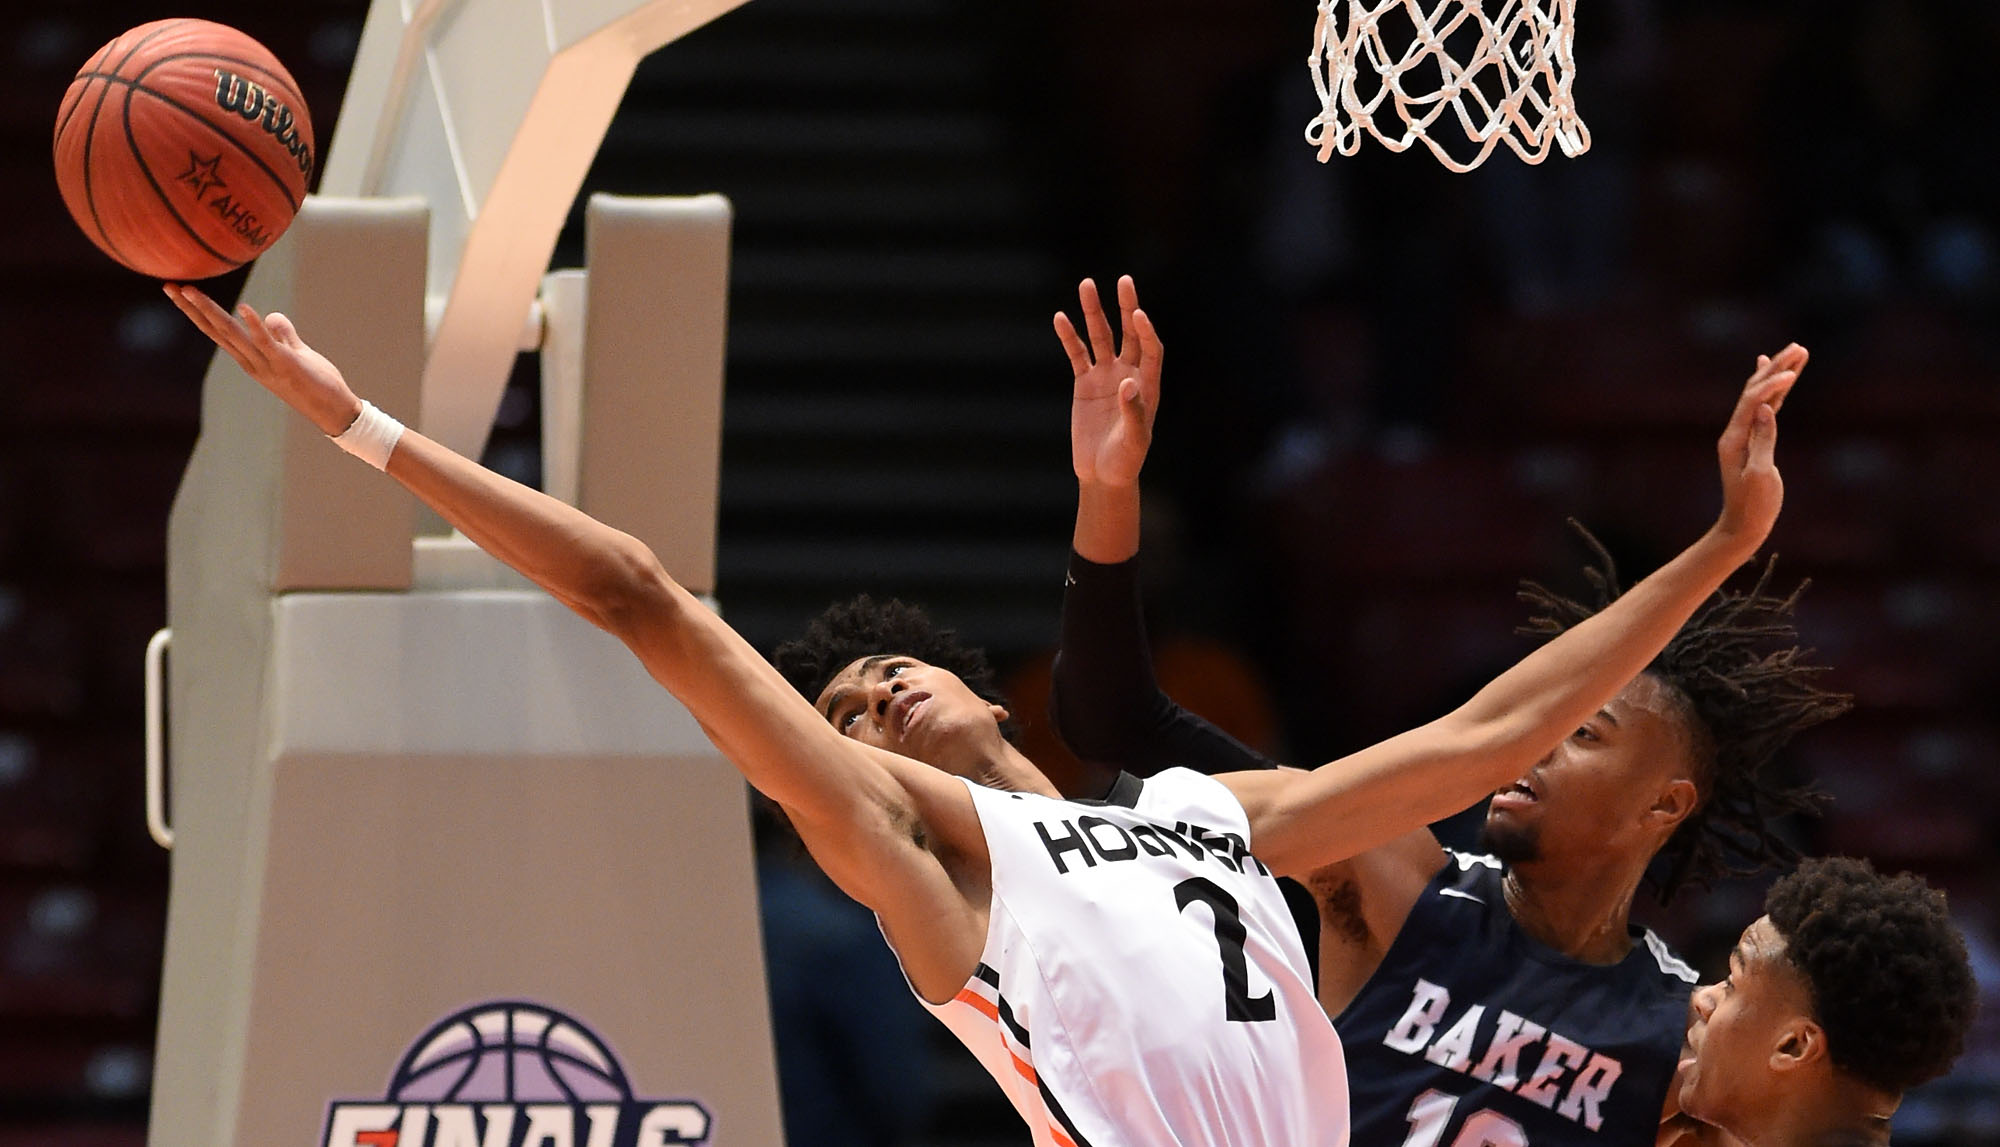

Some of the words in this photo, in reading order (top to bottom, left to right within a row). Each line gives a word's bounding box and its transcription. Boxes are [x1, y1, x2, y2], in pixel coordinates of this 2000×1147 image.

[214, 69, 312, 185] Wilso
[1033, 815, 1269, 874] HOOVER
[1173, 876, 1276, 1022] 2
[1382, 977, 1622, 1133] BAKER
